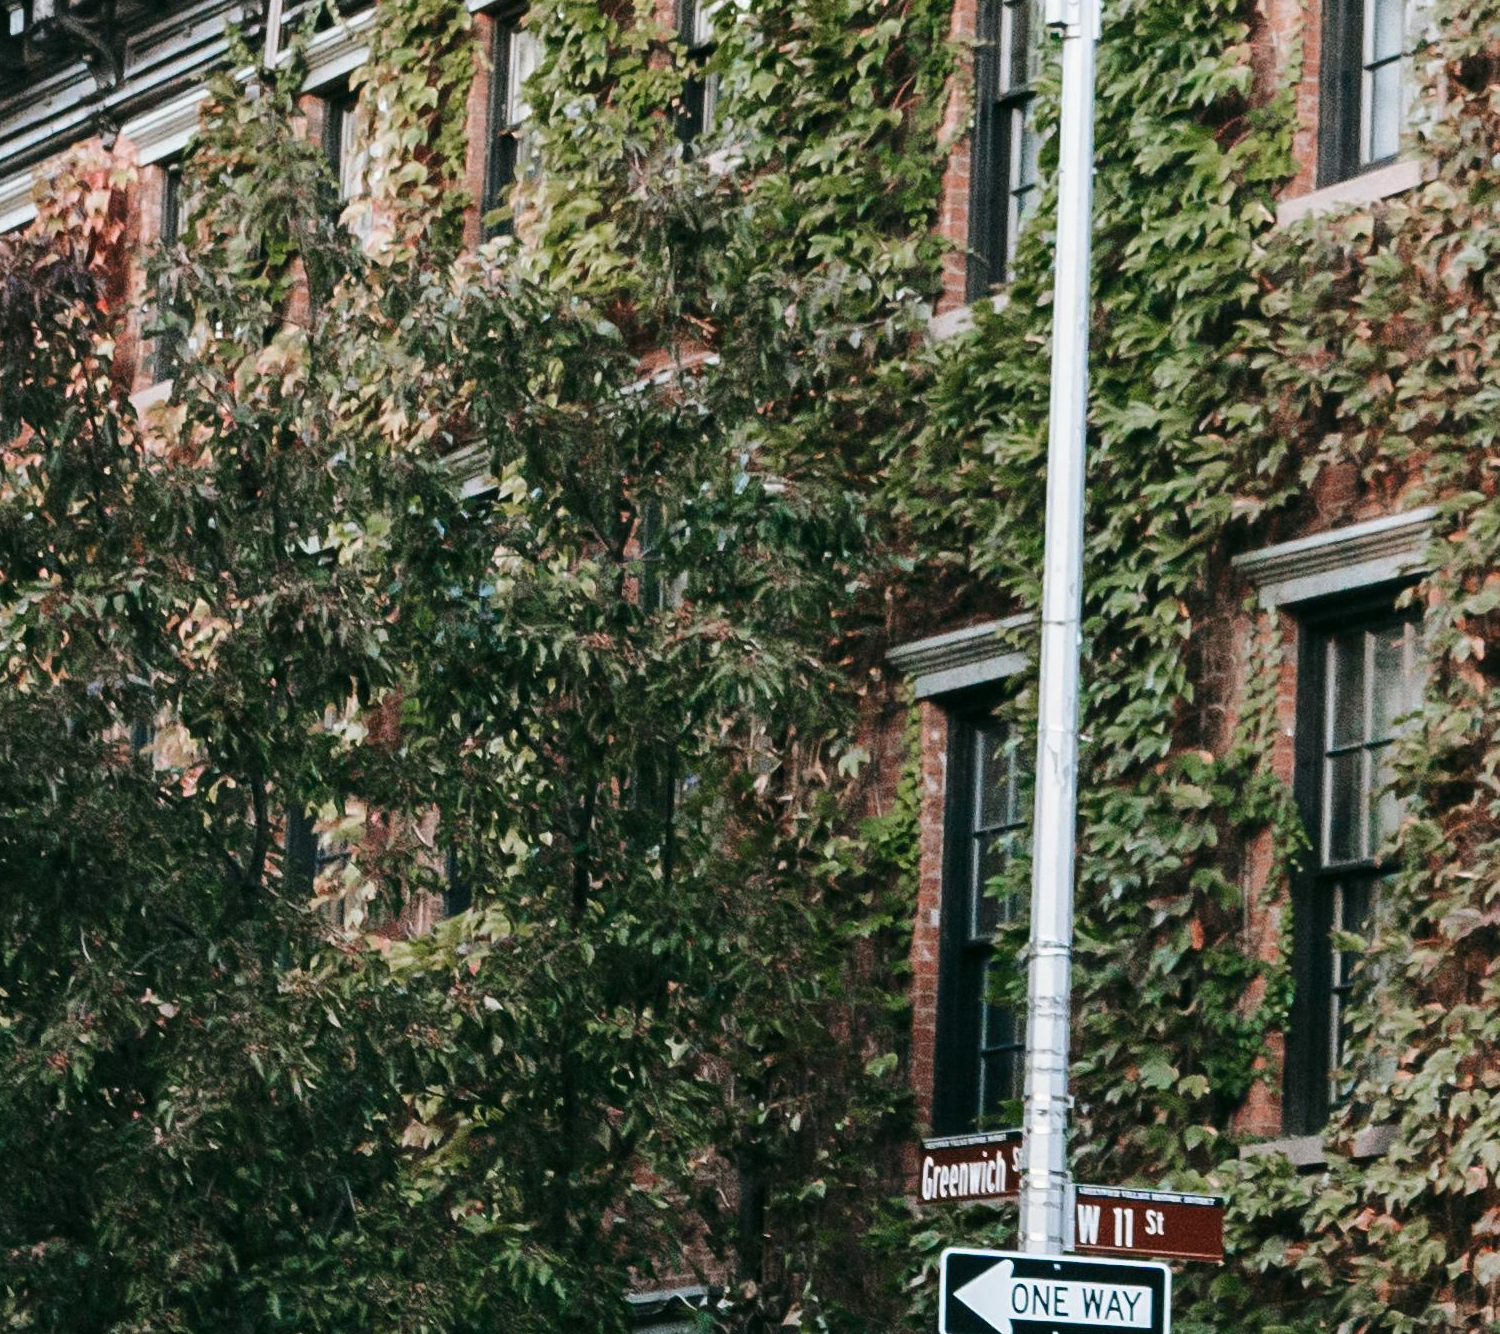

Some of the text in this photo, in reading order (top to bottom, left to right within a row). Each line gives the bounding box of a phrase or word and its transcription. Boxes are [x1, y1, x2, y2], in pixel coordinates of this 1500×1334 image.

[922, 1150, 1007, 1200] Greenwich
[1077, 1203, 1165, 1247] W 11 St
[1011, 1283, 1142, 1322] ONE WAY
